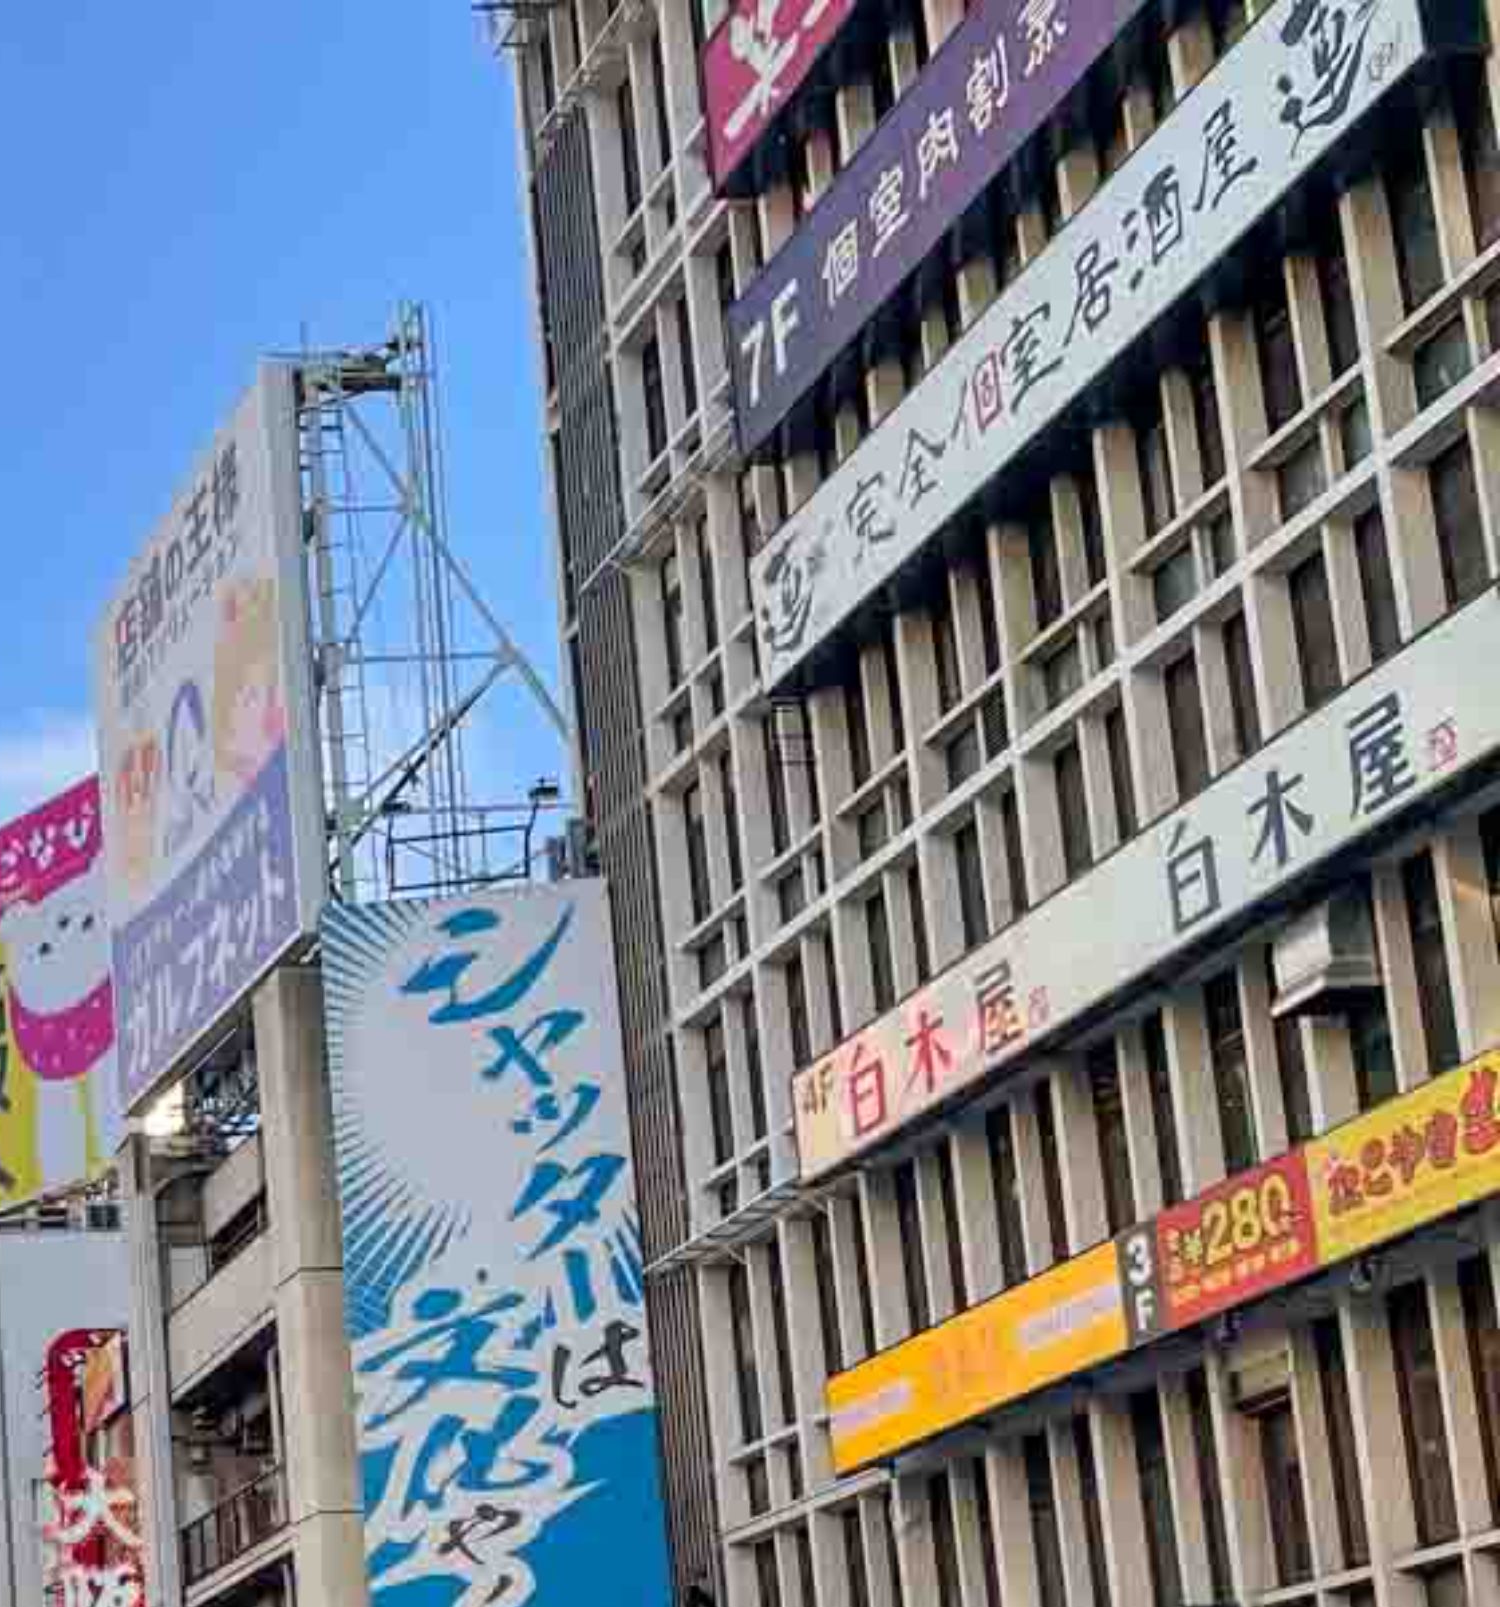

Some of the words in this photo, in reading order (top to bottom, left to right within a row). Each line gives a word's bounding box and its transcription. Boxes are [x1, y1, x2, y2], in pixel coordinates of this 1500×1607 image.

[740, 277, 799, 410] 7F
[845, 99, 1259, 559] 完全個室居酒屋
[1164, 690, 1418, 931] 白木屋
[846, 956, 1029, 1138] 白木屋
[400, 904, 646, 1410] シャッターは
[1126, 1234, 1155, 1333] 3F
